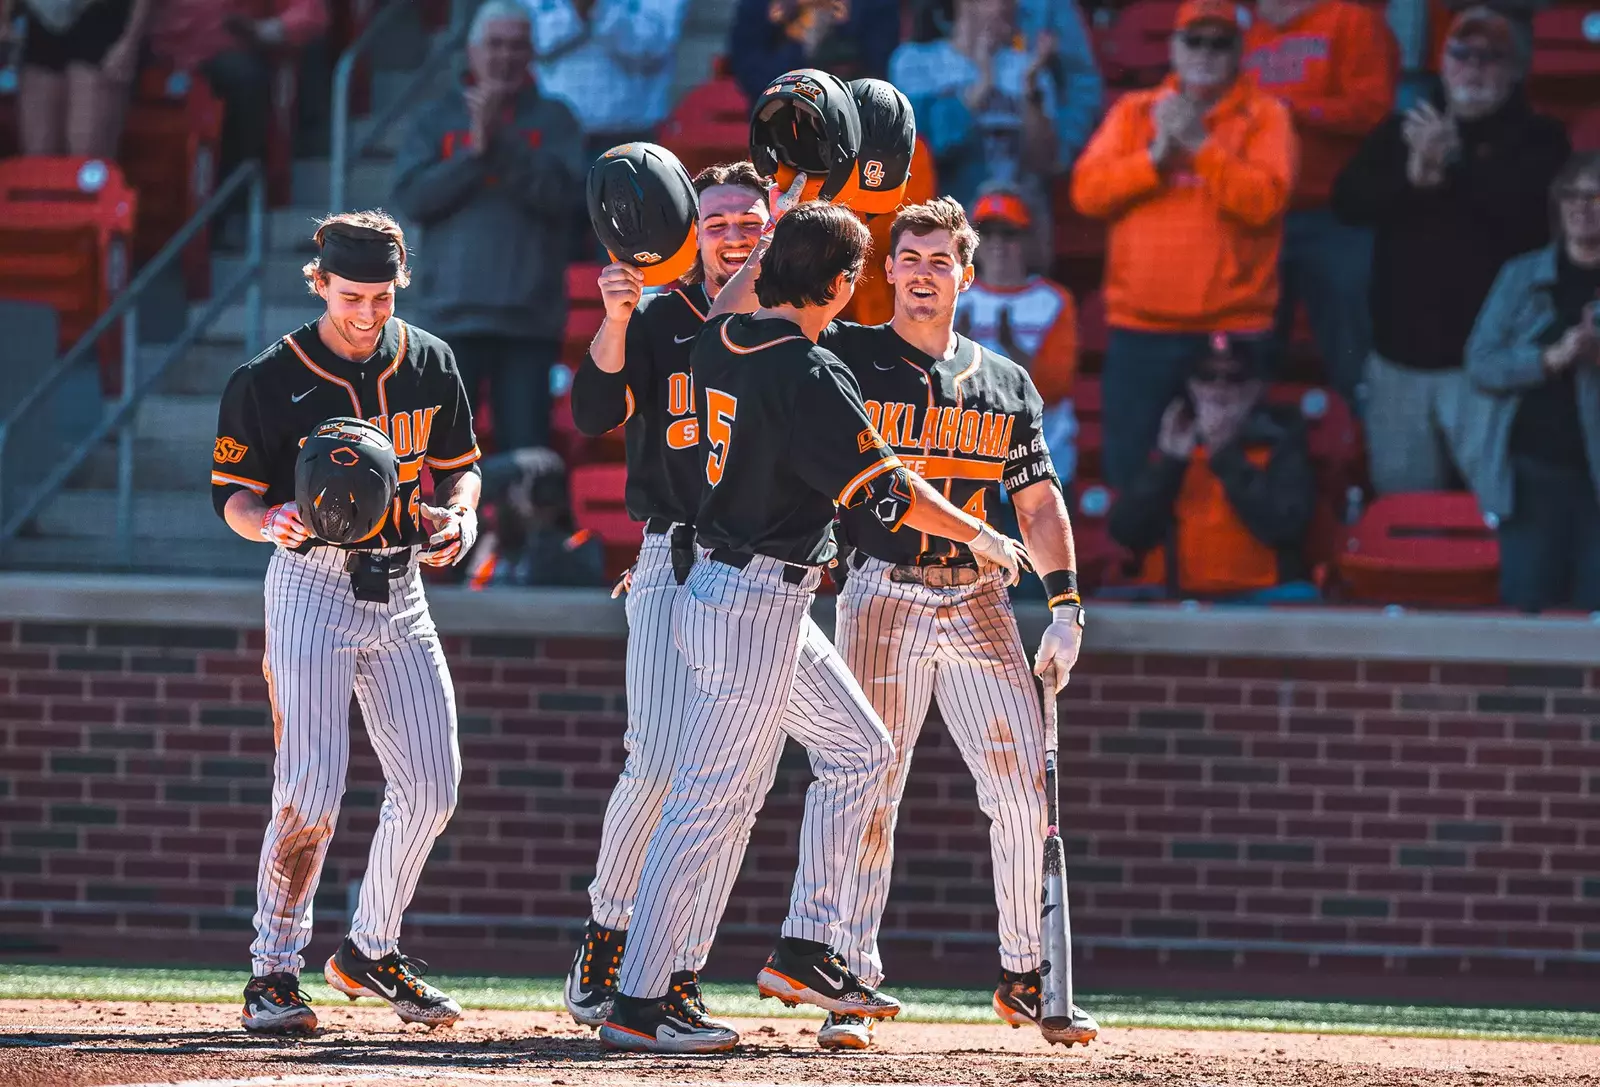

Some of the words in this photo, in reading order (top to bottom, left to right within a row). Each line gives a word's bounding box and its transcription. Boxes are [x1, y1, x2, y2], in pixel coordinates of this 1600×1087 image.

[683, 422, 699, 441] S
[705, 387, 738, 489] 5
[862, 400, 1015, 458] OKLAHOMA
[1007, 443, 1028, 461] ah
[903, 460, 927, 476] TE
[1004, 467, 1029, 490] end
